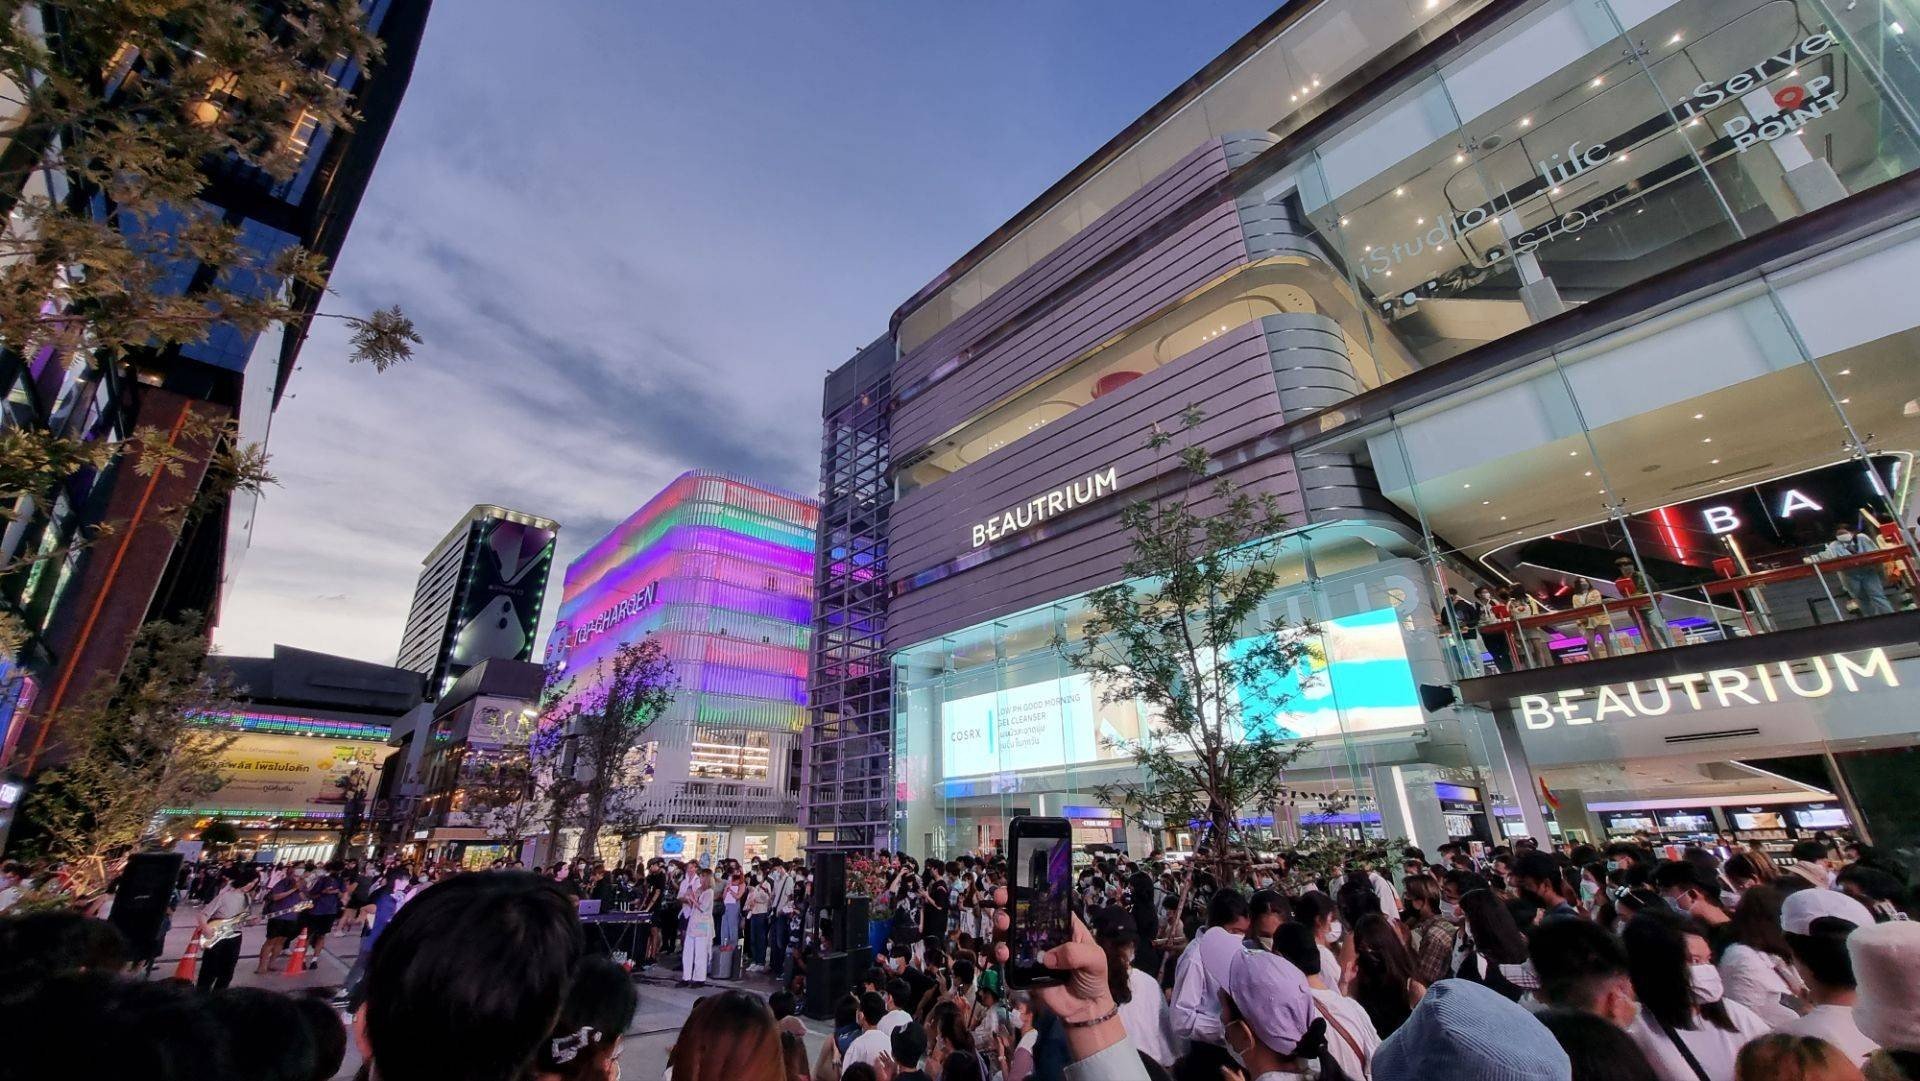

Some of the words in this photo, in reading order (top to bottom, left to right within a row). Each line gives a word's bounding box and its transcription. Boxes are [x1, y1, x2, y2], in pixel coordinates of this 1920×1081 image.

[1678, 33, 1832, 119] iServe
[1733, 91, 1840, 153] POINT
[1358, 207, 1487, 281] iStudio
[972, 466, 1118, 548] BEAUTRIUM
[1011, 711, 1047, 725] CLEANSER
[1023, 702, 1043, 712] GOOD
[1045, 694, 1081, 708] MORNING
[1520, 647, 1899, 730] BEAUTRIUM
[951, 729, 982, 742] COSRX
